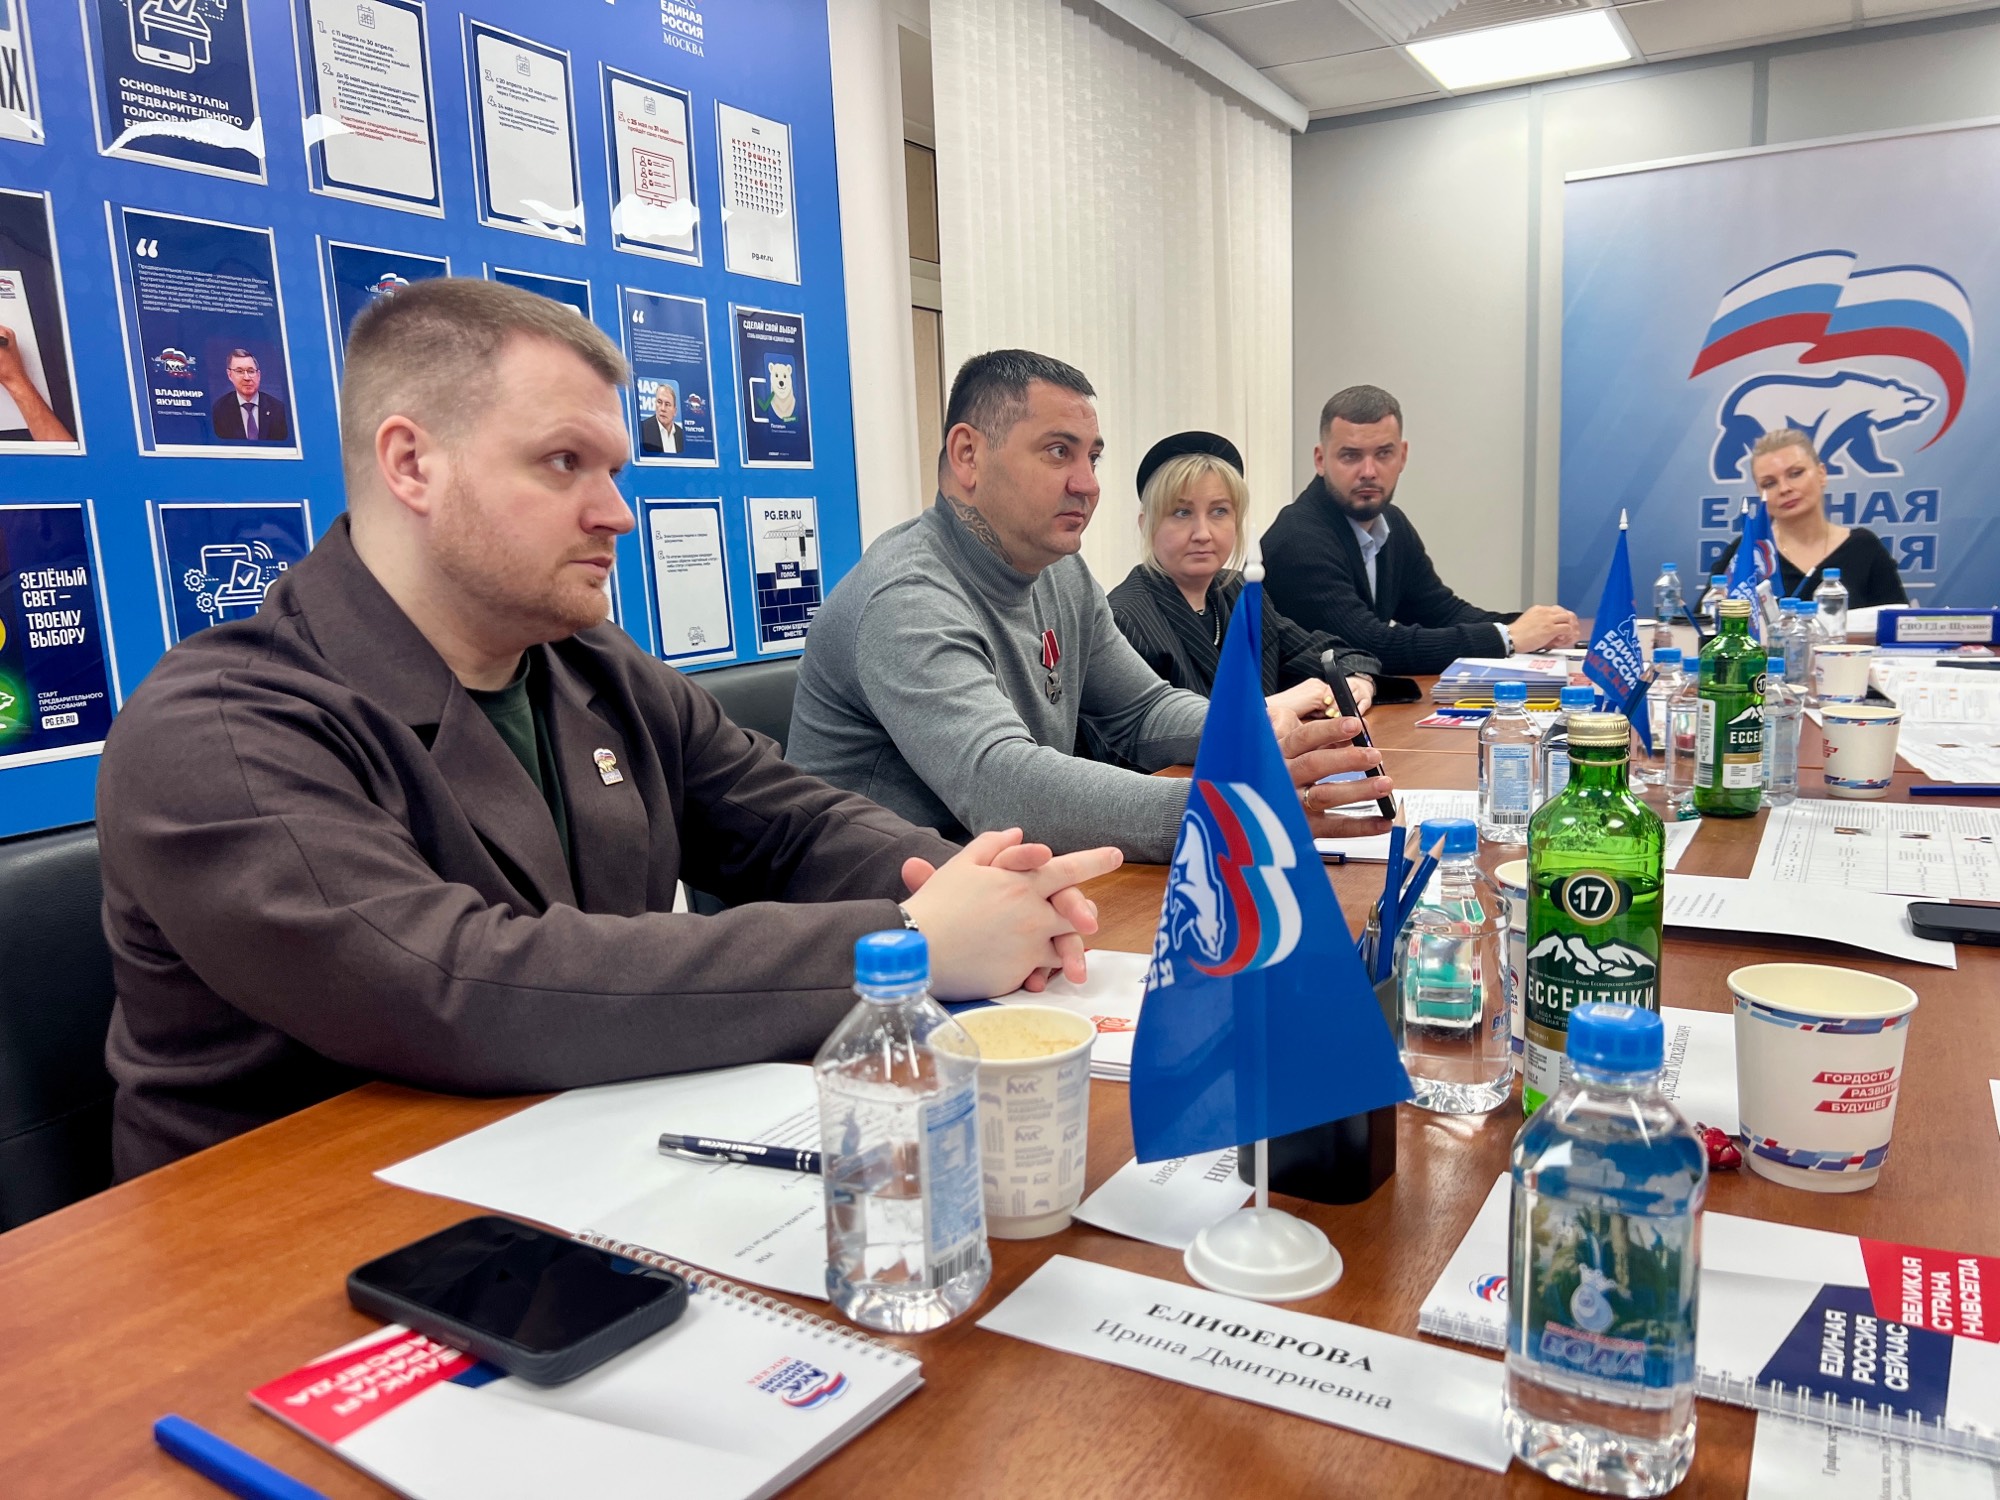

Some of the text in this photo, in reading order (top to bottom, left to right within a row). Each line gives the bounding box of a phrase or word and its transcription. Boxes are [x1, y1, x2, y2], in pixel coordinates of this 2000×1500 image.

[660, 0, 703, 25] ЕДИНАЯ
[661, 12, 703, 40] РОССИЯ
[663, 31, 704, 57] МОСКВА
[119, 77, 229, 110] ОСНОВНЫЕ ЭТАПЫ
[121, 91, 243, 126] ПРЕДВАРИТЕЛЬНОГО
[752, 252, 773, 262] pg.er.ru
[743, 320, 797, 334] СДЕЛАЙ СВОЙ ВЫБОР
[155, 389, 203, 398] ВЛАДИМИР
[156, 398, 192, 407] ЯКУШЕВ
[764, 510, 801, 520] PG.ER.RU
[20, 567, 87, 589] ЗЕЛЁНЫЙ
[22, 590, 56, 608] СВЕТ
[26, 610, 81, 630] ТВОЕМУ
[29, 628, 85, 648] ВЫБОРУ
[1604, 629, 1643, 681] ЕДИНА
[38, 691, 58, 699] СТАРТ
[39, 692, 103, 705] ПРЕДВАРИТЕЛЬНОГО
[40, 701, 87, 712] ГОЛОСОВАНИЯ
[45, 716, 76, 727] PG.ER.RU
[1824, 1070, 1890, 1084] ГОРДОСТЬ
[1831, 1099, 1887, 1113] БУДУЩЕЕ
[1902, 1256, 1923, 1327] ВЕЛИКАЯ
[1930, 1271, 1954, 1330] СТРАНА
[1958, 1259, 1984, 1336] НАВСЕГДА
[1145, 1302, 1374, 1373] ЕЛИФЕРОВА
[1820, 1309, 1847, 1377] ЕДИНАЯ
[1852, 1314, 1877, 1385] РОССИЯ
[1092, 1317, 1394, 1412] Ирина Дмитриевна
[1543, 1337, 1646, 1377] ВОДА
[1884, 1324, 1909, 1391] СЕЙЧАС
[746, 1356, 792, 1386] МОСКВА
[758, 1360, 804, 1391] РОССИЯ
[767, 1363, 812, 1395] ЕДИНАЯ
